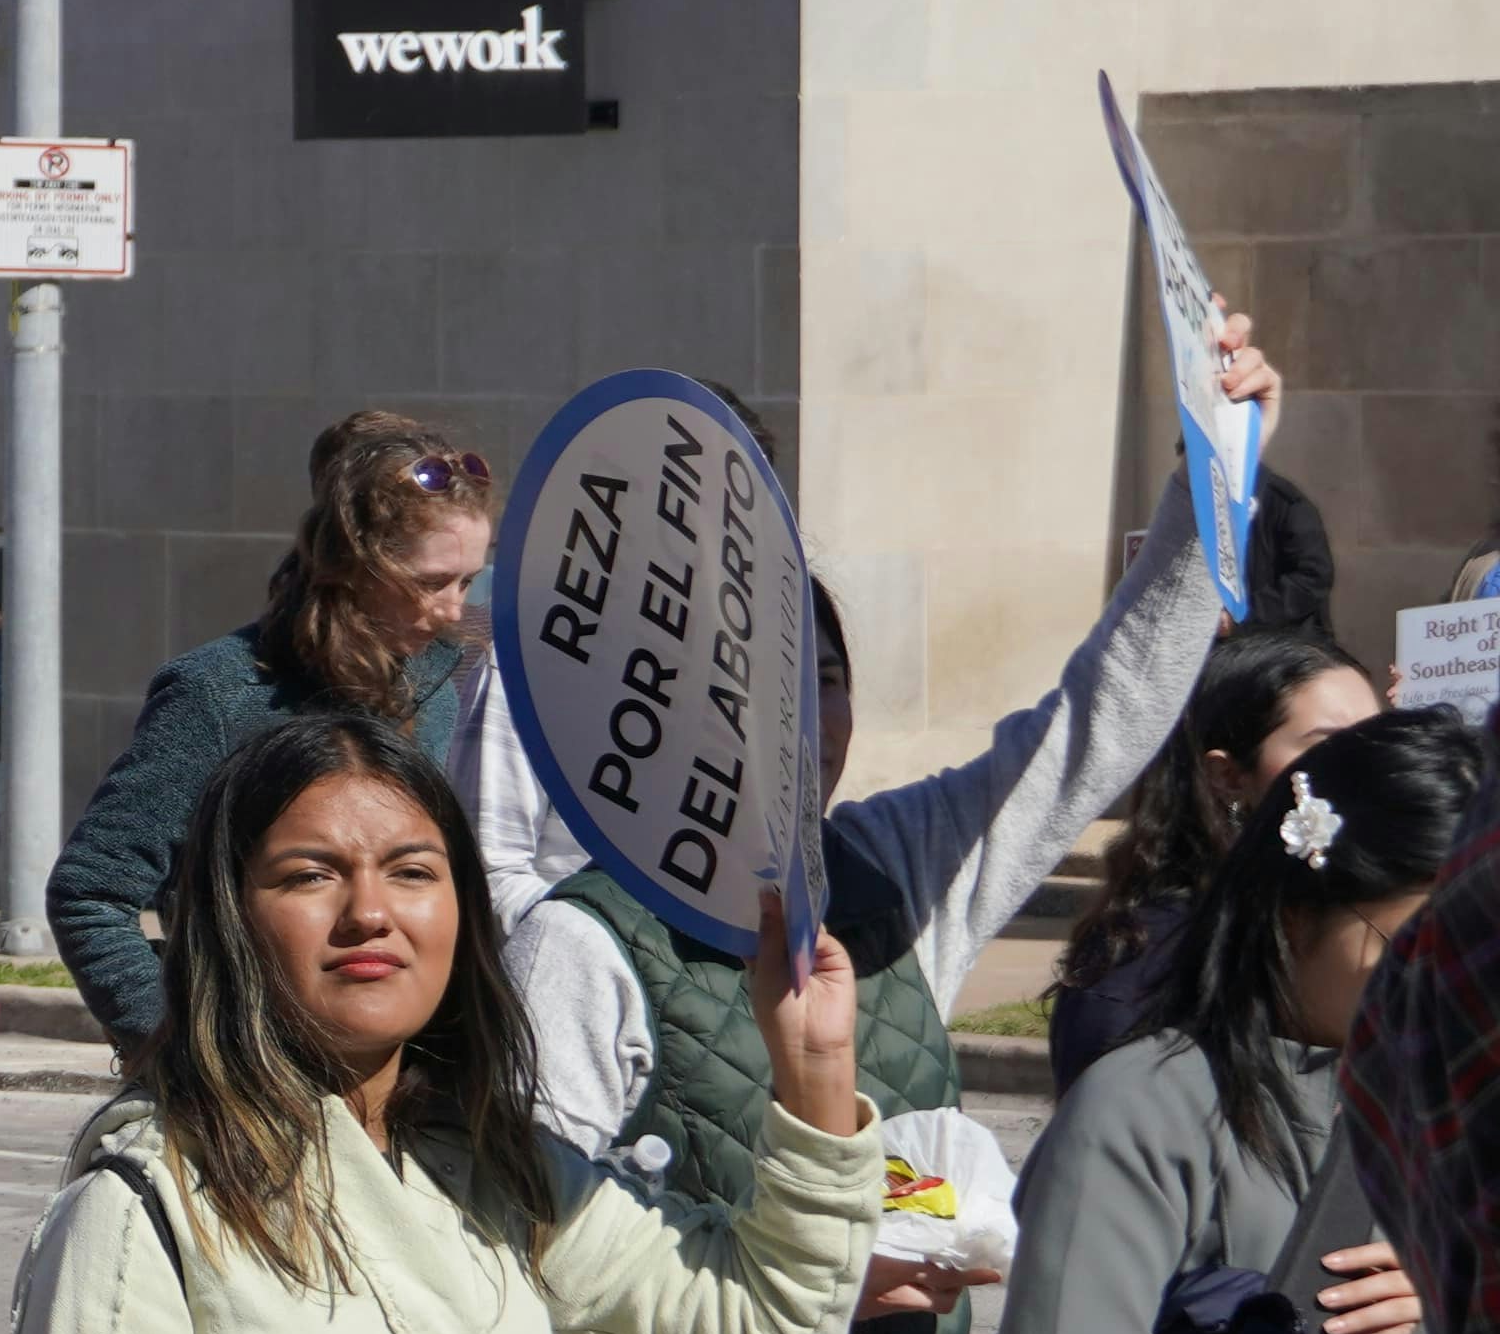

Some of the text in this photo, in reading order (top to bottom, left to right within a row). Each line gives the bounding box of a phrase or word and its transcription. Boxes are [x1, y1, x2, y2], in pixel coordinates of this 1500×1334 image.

[337, 5, 568, 73] wework
[539, 473, 629, 665] REZA
[588, 413, 705, 815] POR EL FIN
[1425, 616, 1477, 642] Right
[658, 447, 756, 895] DEL ABORTO
[1477, 631, 1498, 652] of
